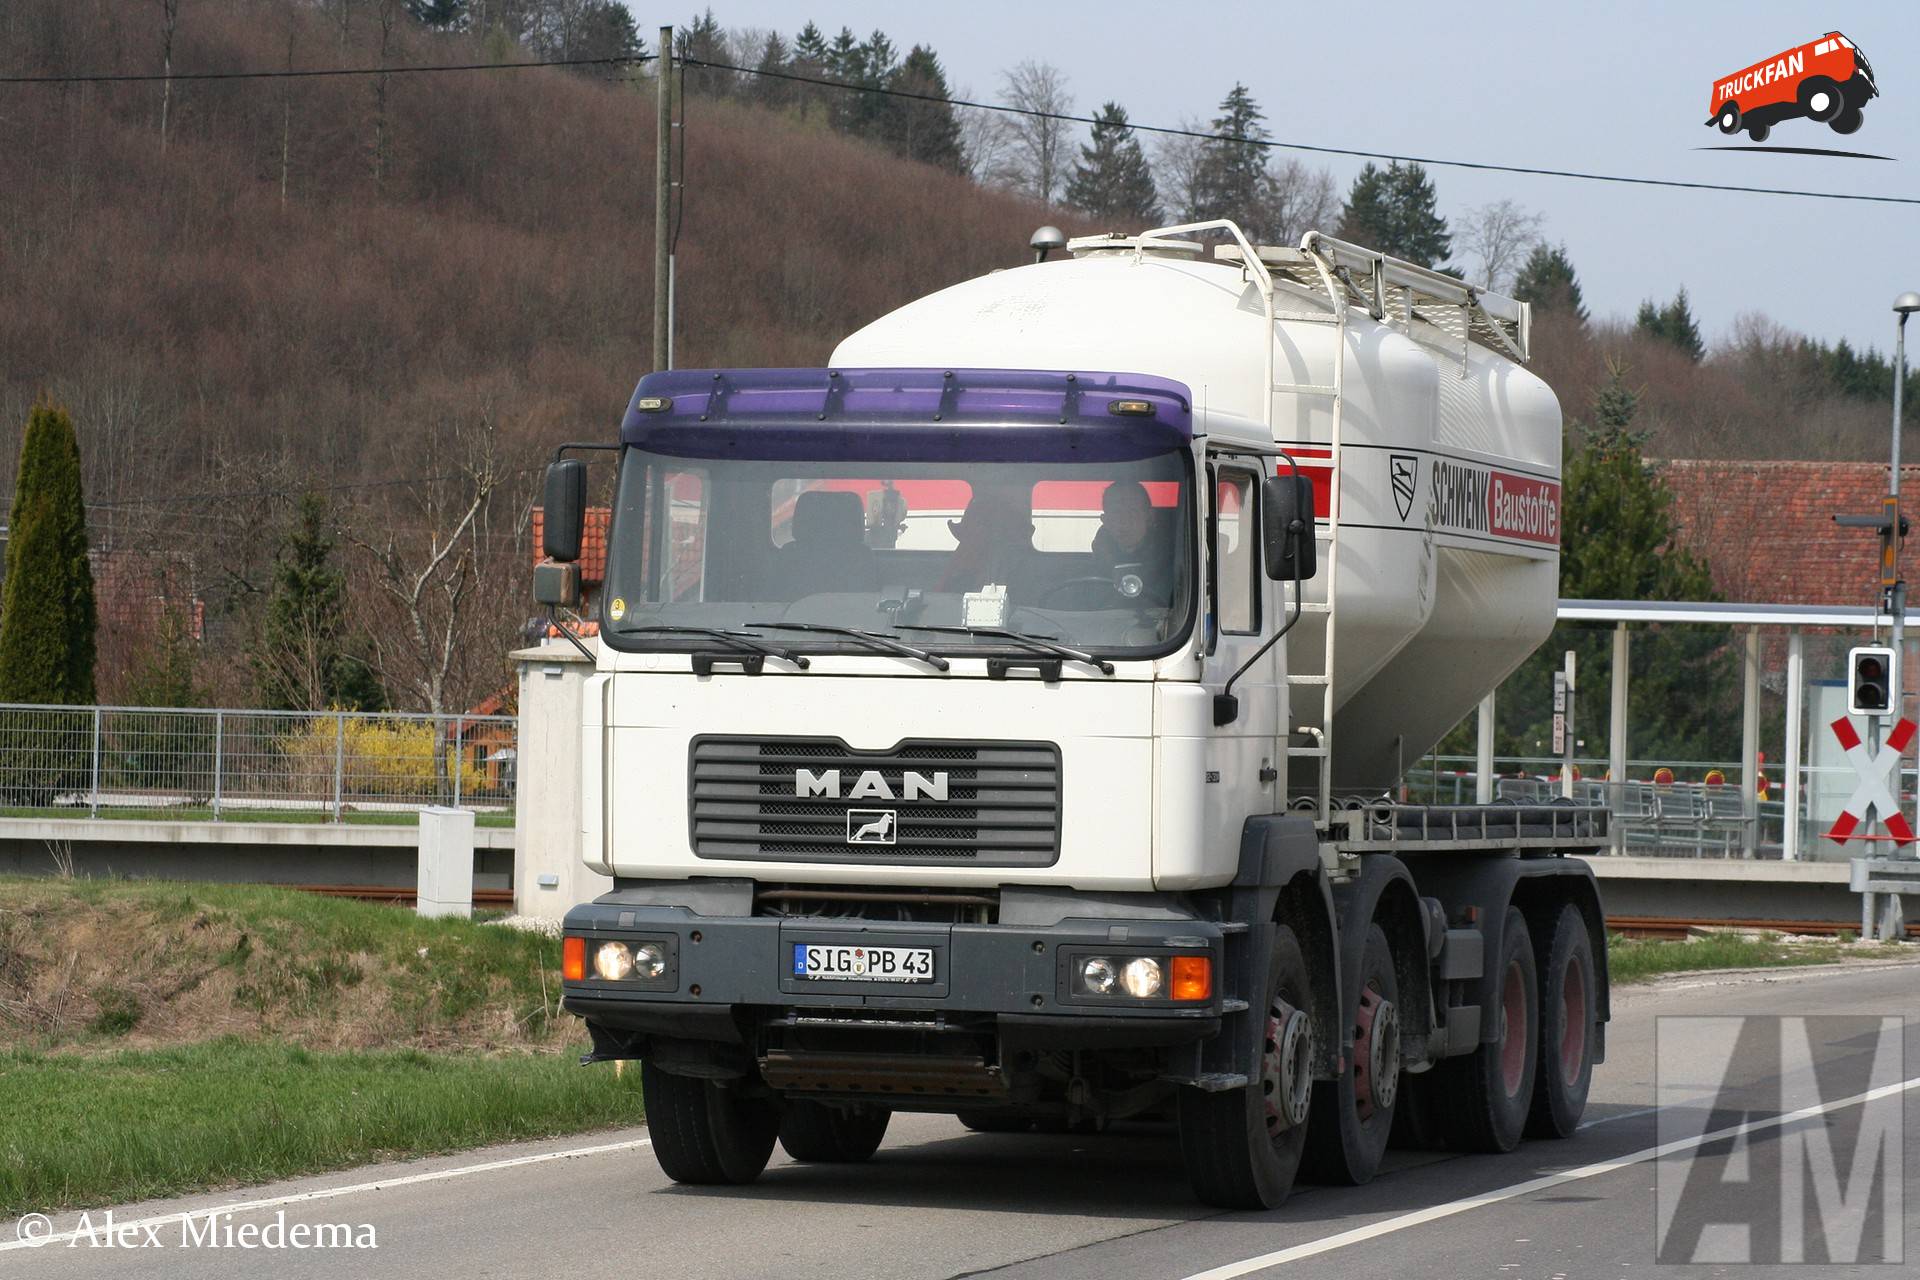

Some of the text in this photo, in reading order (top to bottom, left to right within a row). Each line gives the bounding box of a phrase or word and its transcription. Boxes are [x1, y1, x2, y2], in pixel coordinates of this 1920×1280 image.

[1432, 460, 1556, 538] SCHWENK Baustoffe
[796, 769, 948, 801] MAN
[807, 949, 851, 972] SIG
[868, 950, 896, 973] PB
[902, 951, 930, 974] 43
